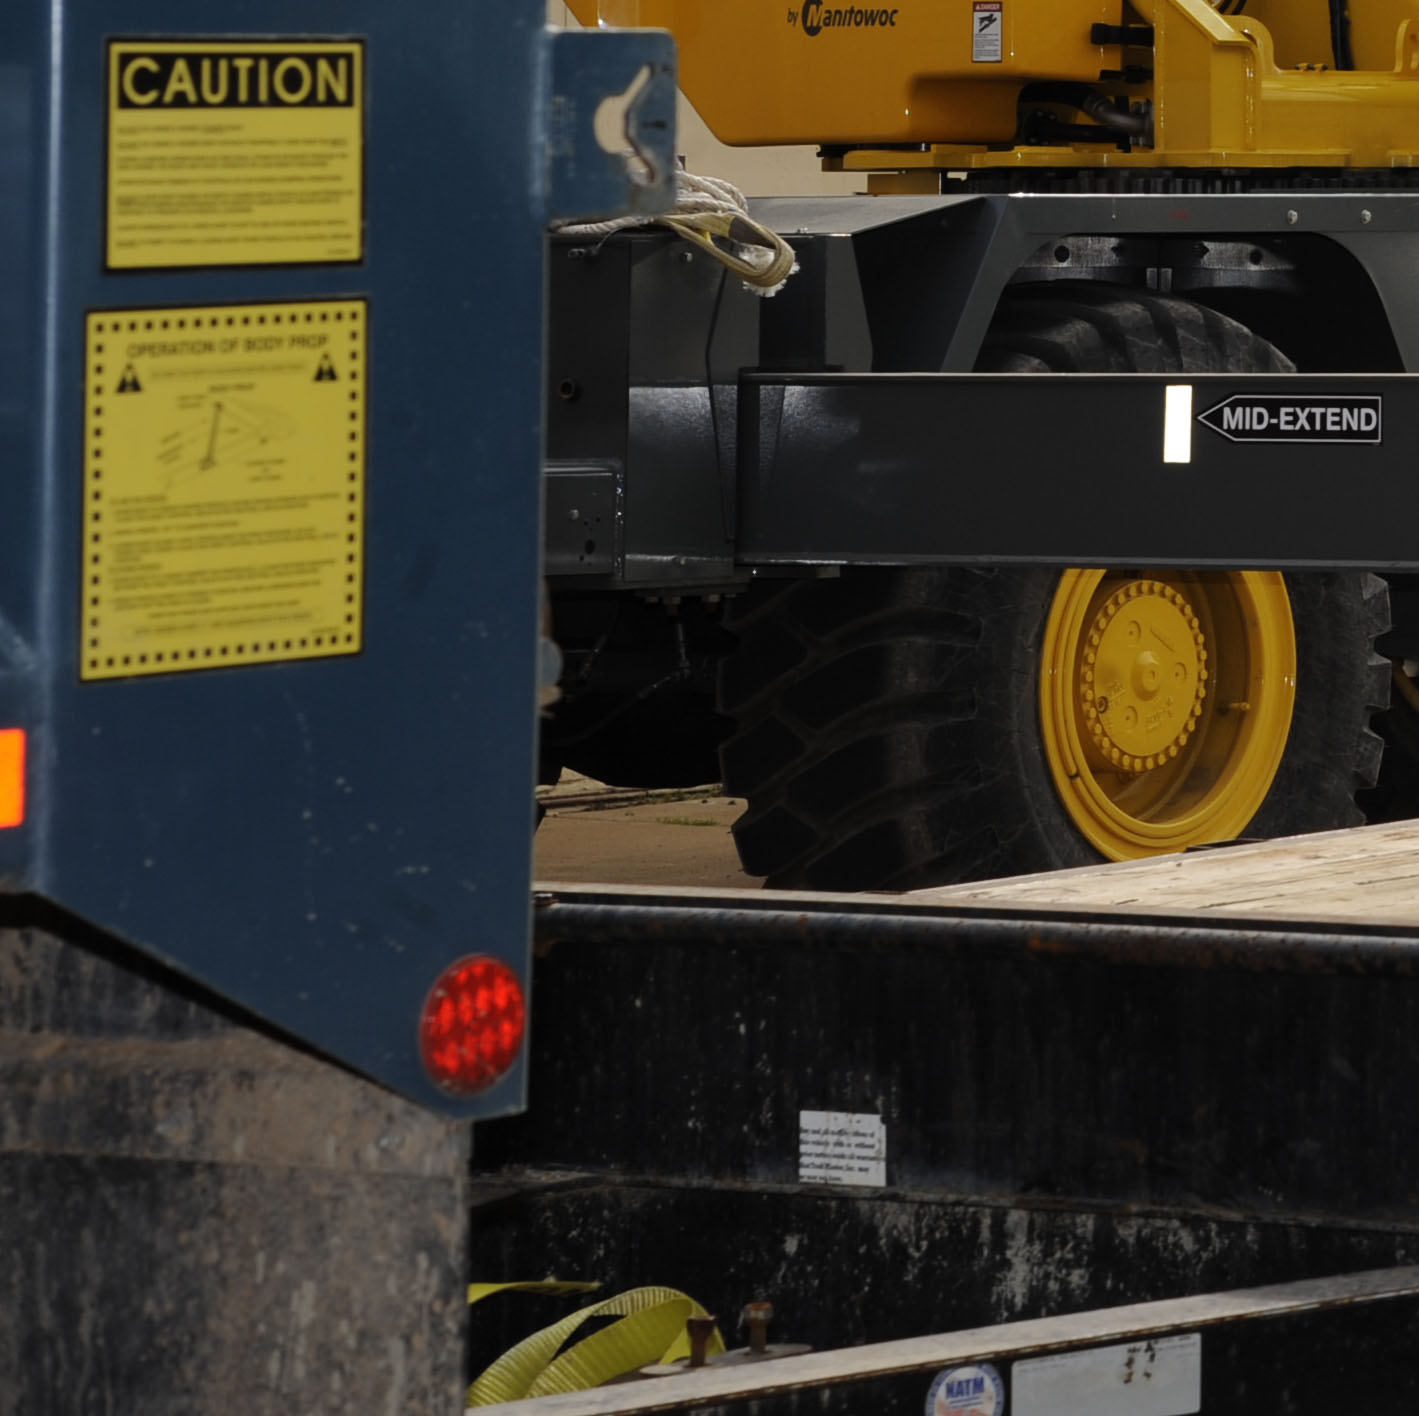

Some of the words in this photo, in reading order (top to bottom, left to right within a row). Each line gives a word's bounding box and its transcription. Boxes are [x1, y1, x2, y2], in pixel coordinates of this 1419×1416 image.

[787, 8, 799, 27] by
[122, 57, 348, 105] CAUTION
[126, 338, 216, 358] OPERATION
[219, 338, 240, 354] OF
[245, 336, 283, 352] BODY
[287, 334, 328, 350] PROP
[1222, 406, 1378, 432] MID-EXTEND
